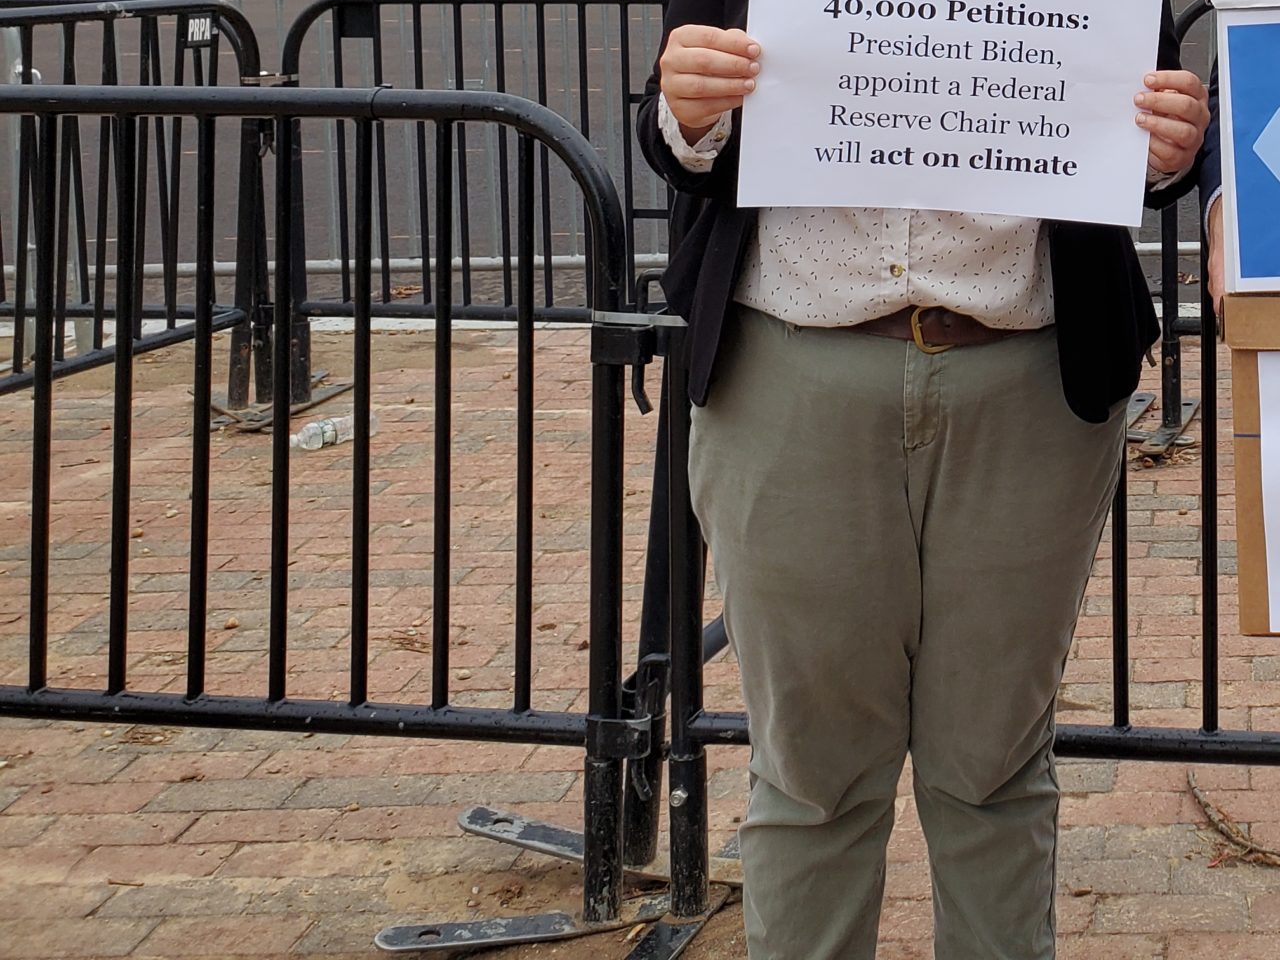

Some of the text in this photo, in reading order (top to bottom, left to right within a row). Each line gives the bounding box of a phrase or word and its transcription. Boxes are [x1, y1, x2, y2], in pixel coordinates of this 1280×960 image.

[187, 16, 211, 42] PRPA
[945, 0, 1089, 29] Petitions:
[847, 31, 1062, 69] President Biden,
[838, 71, 1066, 102] appoint a Federal
[828, 104, 1070, 139] Reserve Chair who
[813, 140, 1078, 177] will act on climate
